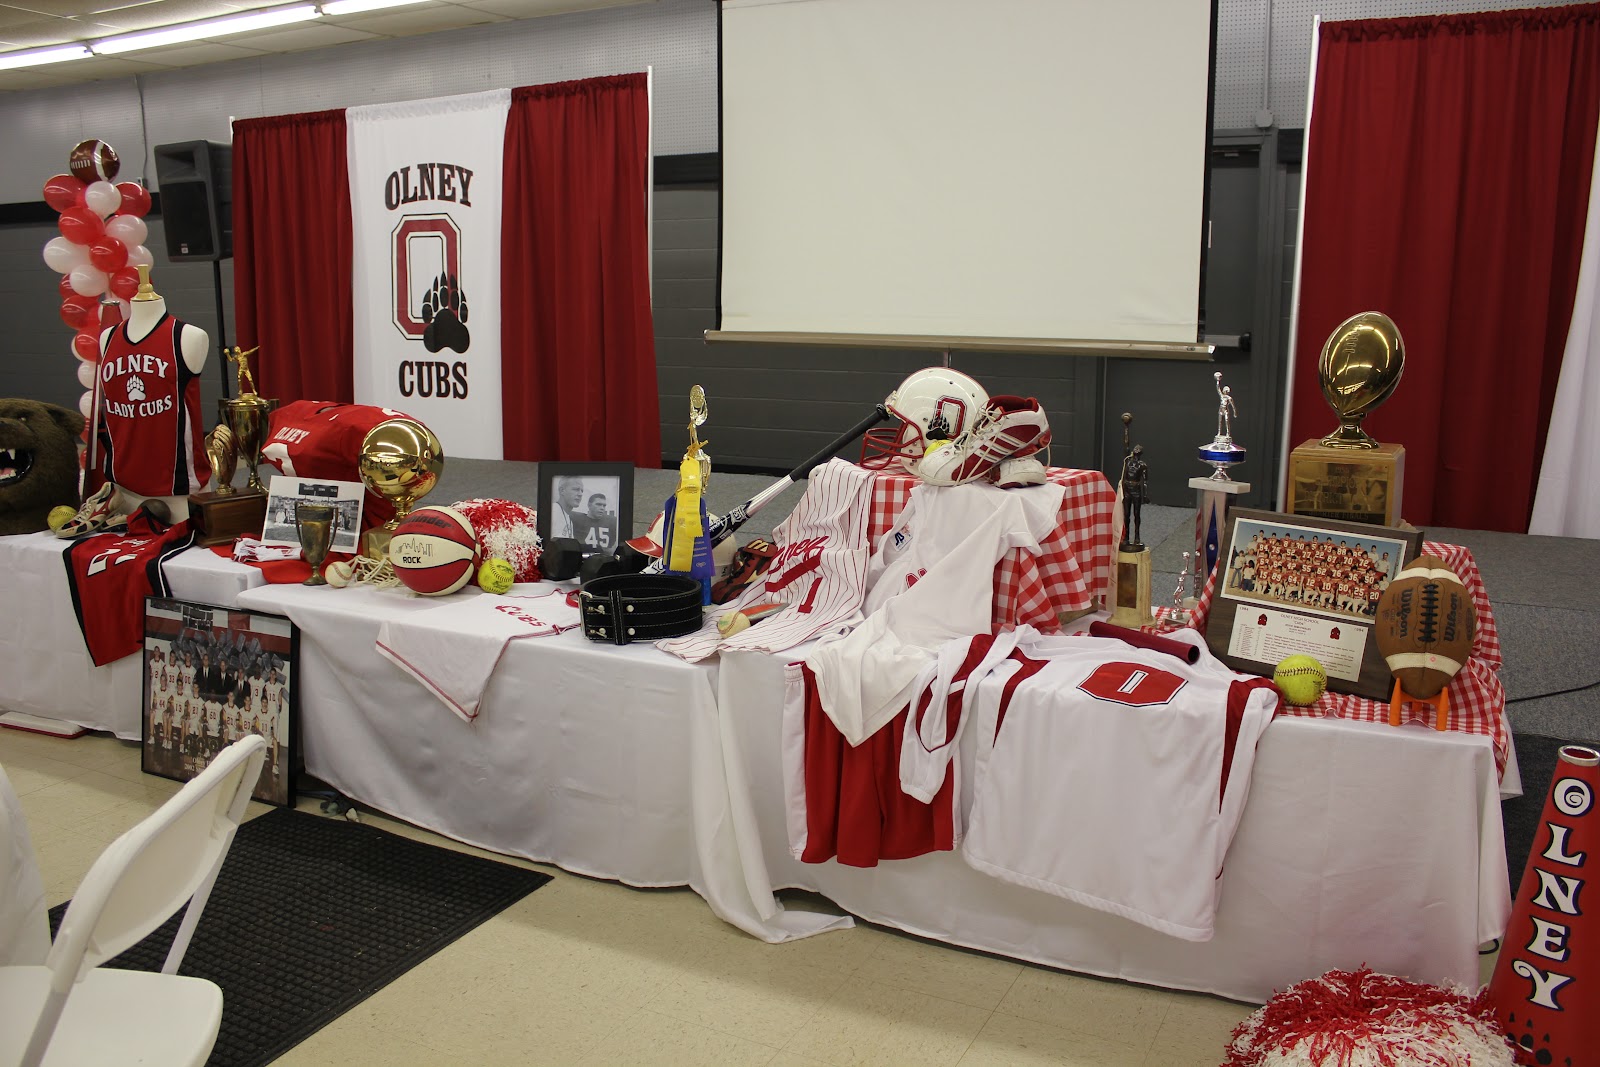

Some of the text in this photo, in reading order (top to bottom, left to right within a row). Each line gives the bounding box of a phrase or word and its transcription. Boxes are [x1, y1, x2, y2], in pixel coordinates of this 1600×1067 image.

[384, 163, 474, 211] OLNEY
[102, 354, 169, 383] OLNEY
[398, 360, 469, 400] CUBS
[105, 395, 172, 418] LADY CUBS
[584, 526, 610, 549] 45
[402, 556, 421, 564] ROCK
[1512, 776, 1596, 1012] OLNEY
